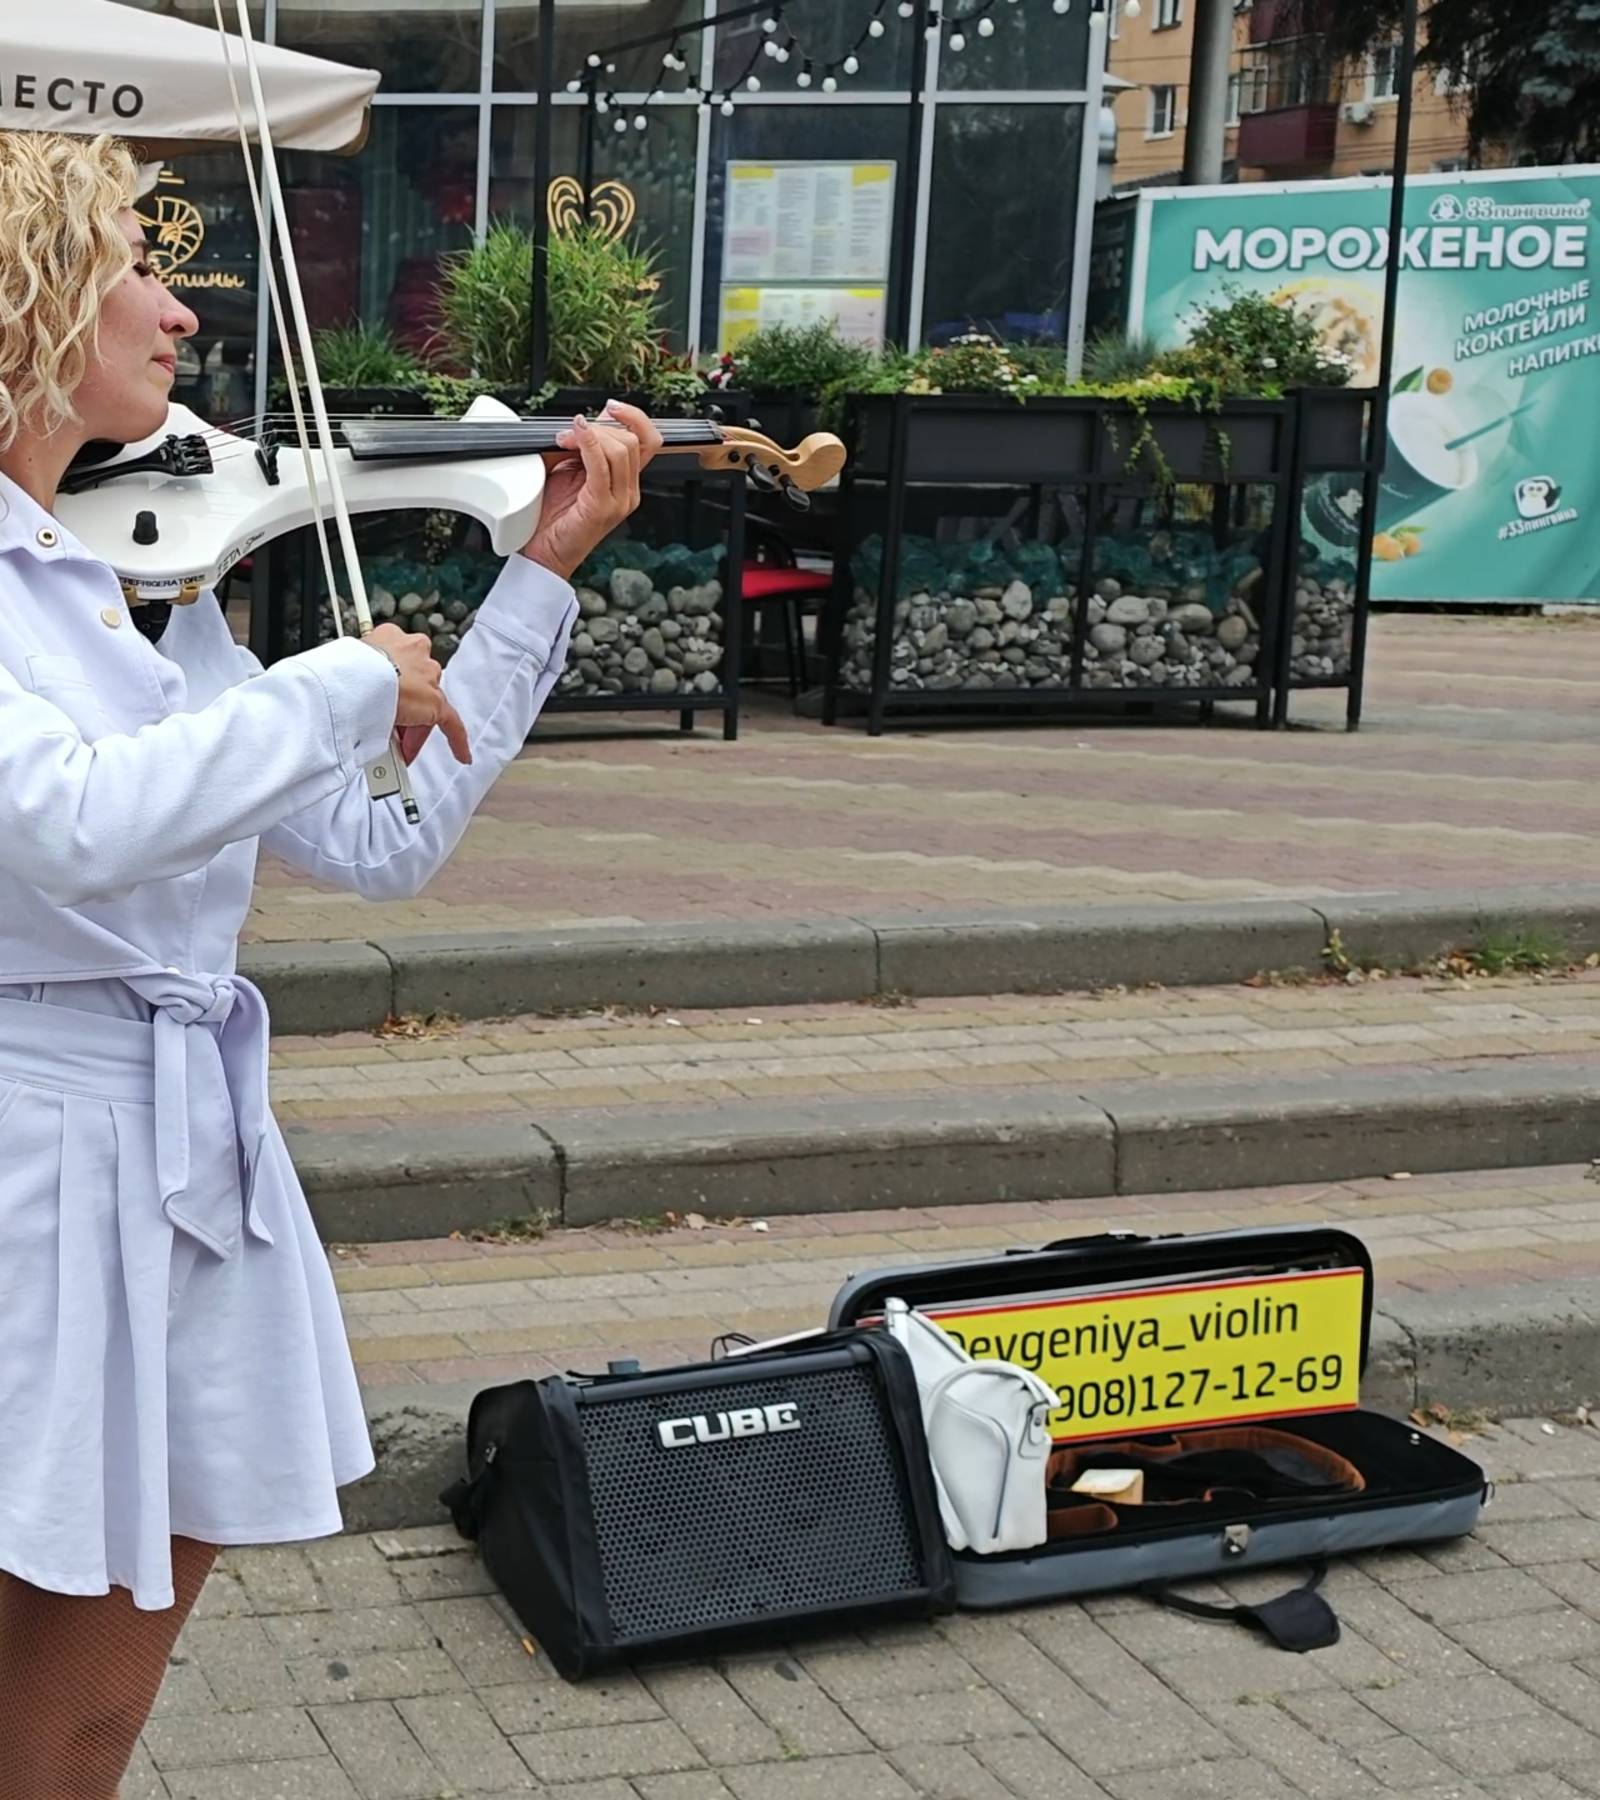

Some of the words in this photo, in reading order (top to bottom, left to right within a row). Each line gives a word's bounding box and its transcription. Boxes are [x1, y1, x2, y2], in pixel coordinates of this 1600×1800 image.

[1193, 226, 1588, 270] МОРОЖЕНОЕ
[1455, 303, 1586, 360] КОКТЕЙЛИ
[1464, 279, 1590, 332] МОЛОЧНЫЕ
[946, 1297, 1299, 1371] evgeniya_violin
[658, 1402, 801, 1448] CUBE
